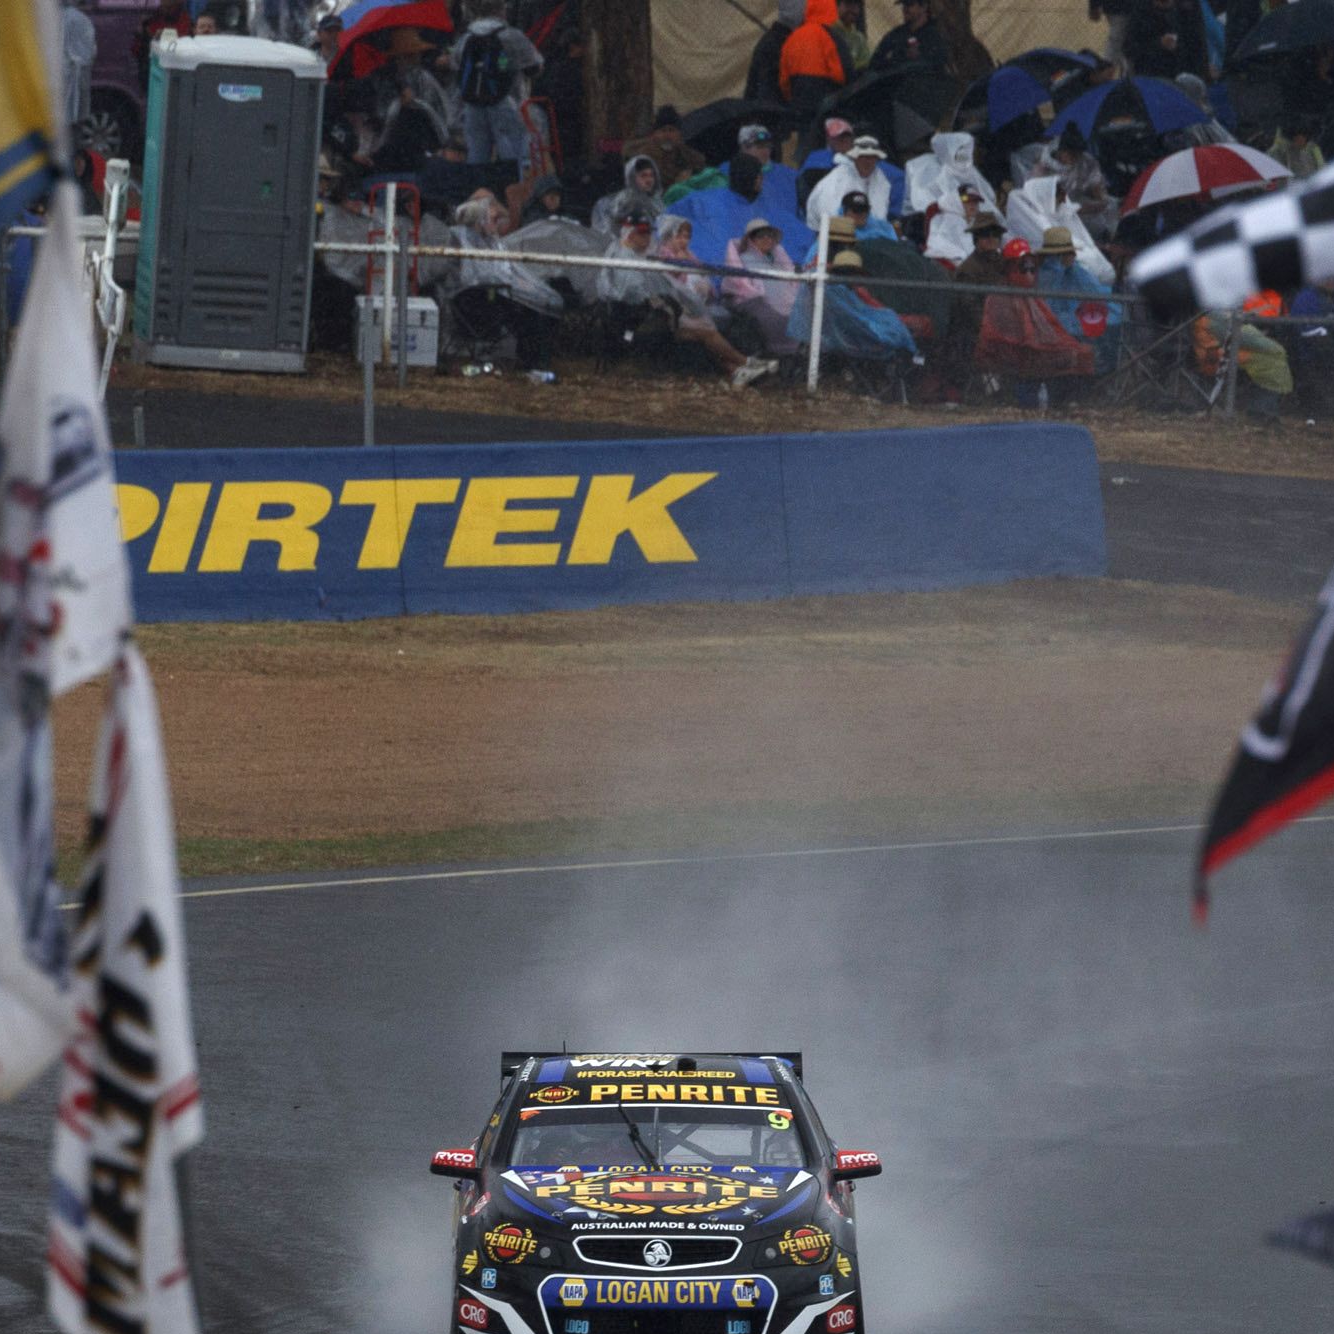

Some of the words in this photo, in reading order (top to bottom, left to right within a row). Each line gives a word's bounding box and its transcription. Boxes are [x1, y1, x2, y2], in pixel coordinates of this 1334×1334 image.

[529, 1089, 580, 1099] PENRITE
[590, 1084, 780, 1105] PENRITE
[768, 1112, 790, 1130] 9
[435, 1151, 474, 1163] RYCO
[840, 1152, 878, 1164] RYCO
[536, 1181, 779, 1198] PENRITE
[571, 1221, 646, 1231] AUSTRALIAN
[649, 1221, 685, 1230] MADE
[687, 1222, 697, 1230] &
[698, 1222, 745, 1231] OWNED
[484, 1231, 538, 1254] PENRITE
[482, 1270, 496, 1286] PPG
[564, 1285, 583, 1299] NAPA
[595, 1280, 669, 1304] LOGAN
[675, 1281, 722, 1304] CITY
[737, 1285, 756, 1300] NAPA
[460, 1303, 486, 1324] CRC
[829, 1309, 854, 1328] CRC
[565, 1318, 589, 1334] LOCO
